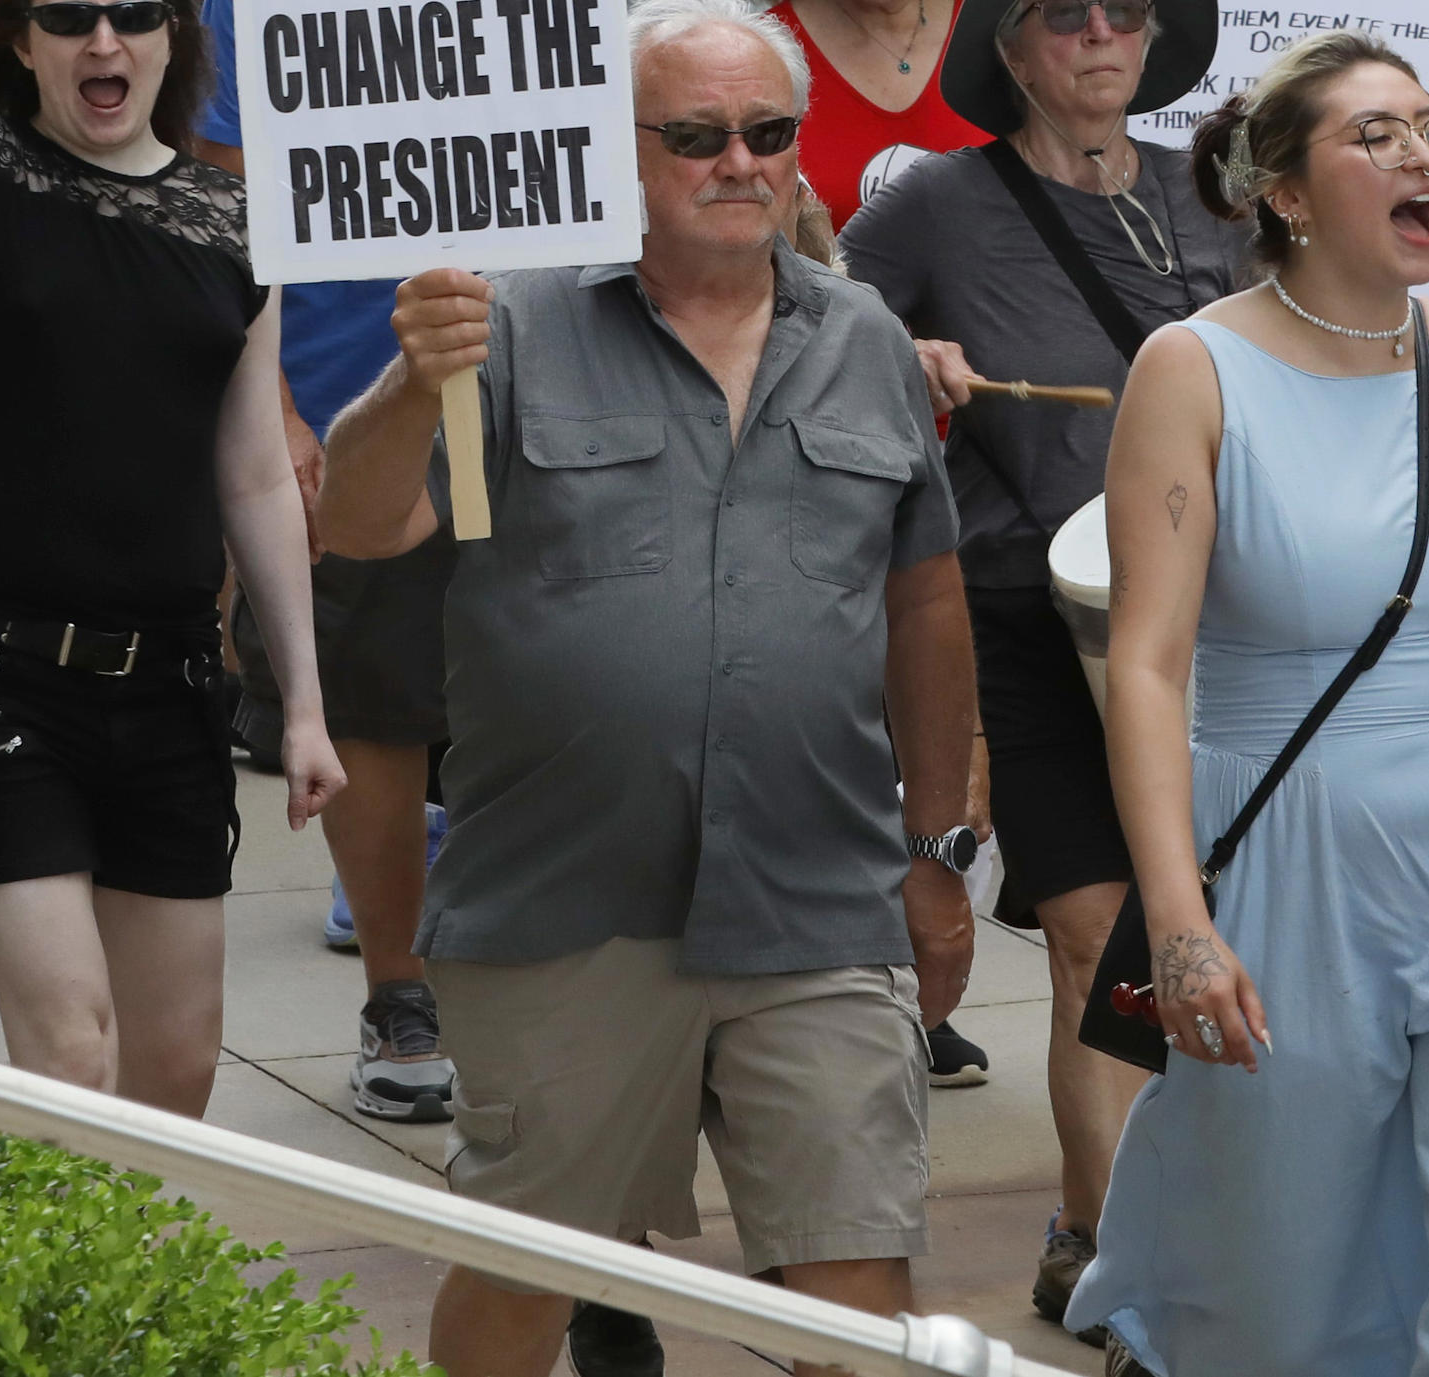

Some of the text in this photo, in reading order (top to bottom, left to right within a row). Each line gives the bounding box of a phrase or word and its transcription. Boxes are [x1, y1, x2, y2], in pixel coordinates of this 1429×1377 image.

[1220, 10, 1280, 29] THEM
[1288, 12, 1349, 31] EVEN
[263, 0, 490, 114] CHANGE
[1151, 111, 1203, 129] THIN
[289, 126, 604, 244] PRESIDENT.
